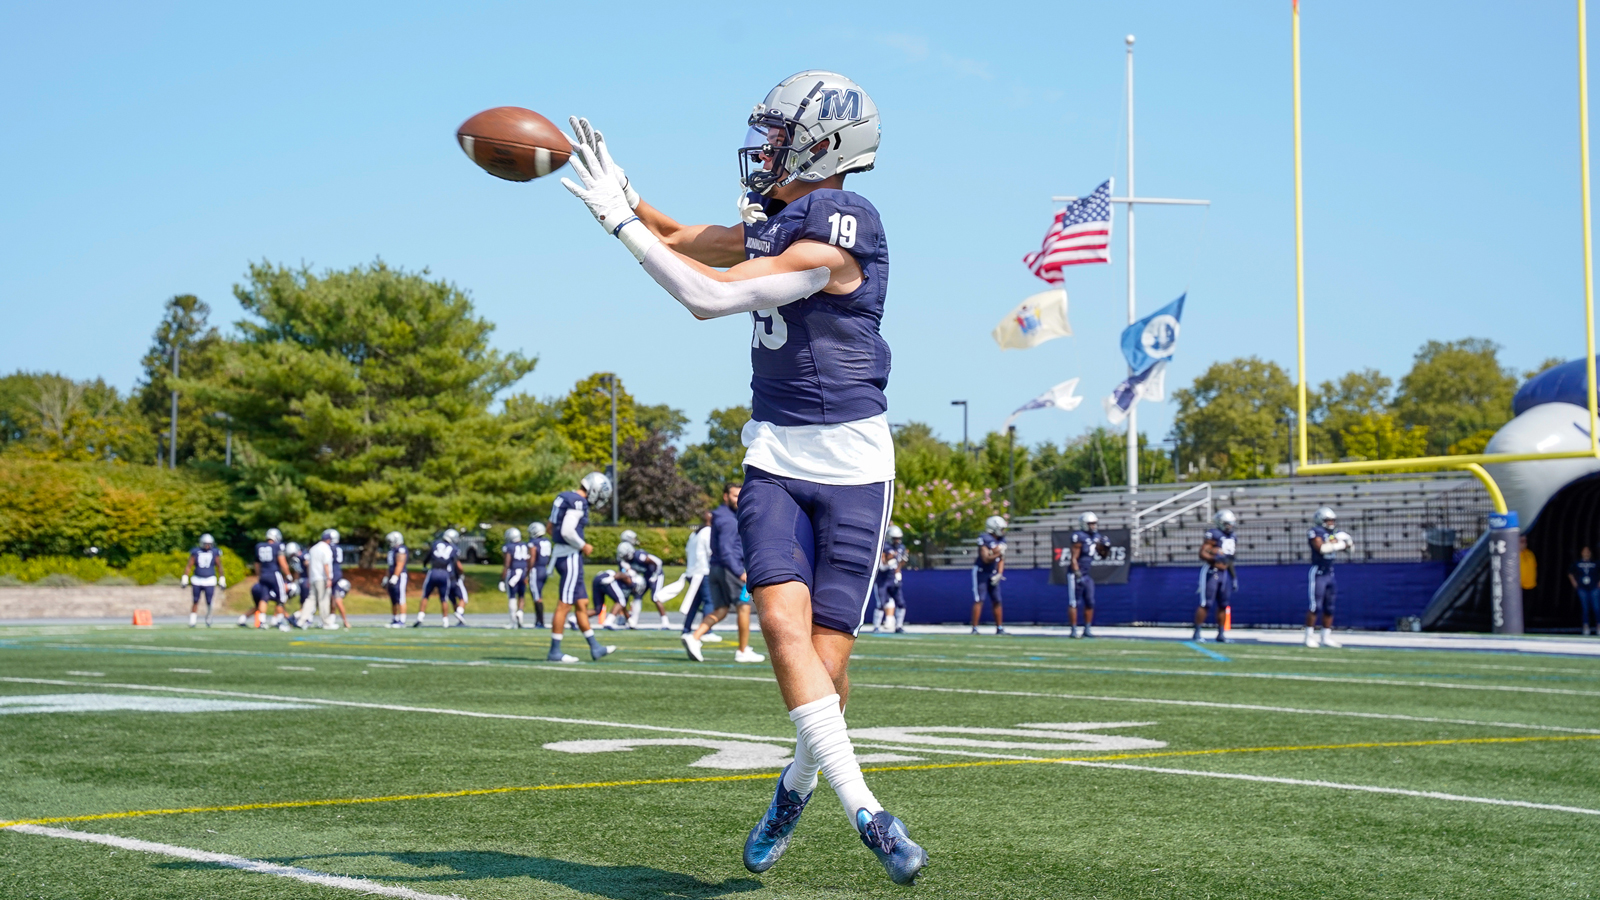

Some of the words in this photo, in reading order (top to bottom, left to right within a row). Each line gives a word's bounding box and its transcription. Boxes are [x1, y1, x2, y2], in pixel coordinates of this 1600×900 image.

[817, 87, 863, 121] M
[828, 213, 857, 249] 19
[1491, 555, 1504, 628] HAWKS
